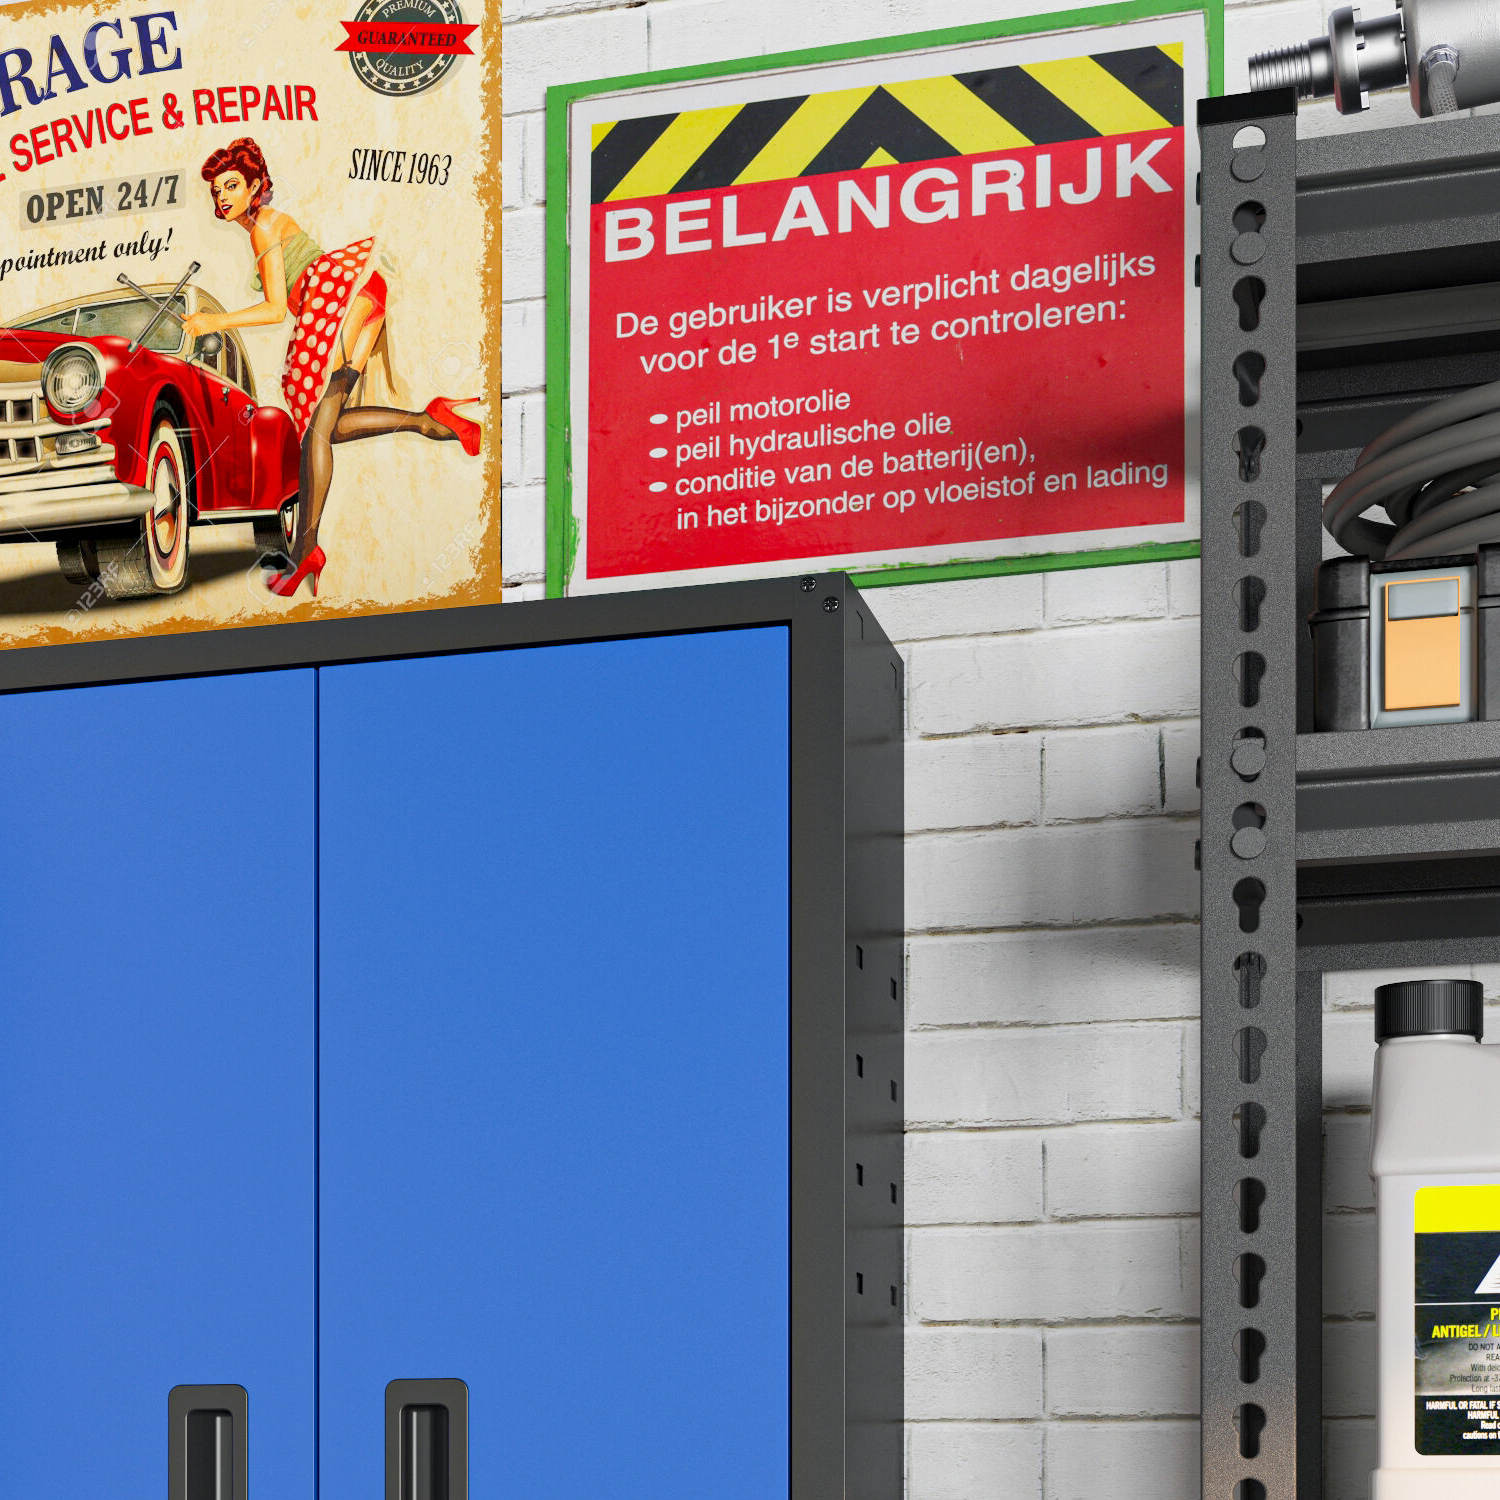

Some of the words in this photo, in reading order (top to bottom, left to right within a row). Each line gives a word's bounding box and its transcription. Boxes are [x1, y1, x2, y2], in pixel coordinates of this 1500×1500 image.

[382, 0, 436, 18] PREMIUM
[357, 31, 456, 46] GUARANTEED
[376, 58, 423, 76] QUALITY
[10, 102, 154, 172] SERVICE
[162, 93, 184, 129] &
[192, 85, 318, 125] REPAIR
[348, 148, 404, 184] SINCE
[408, 152, 452, 185] 1963
[26, 186, 104, 224] OPEN
[118, 175, 180, 210] 24/7
[605, 138, 1173, 262] BELANGRIJK
[113, 228, 174, 268] only!
[615, 310, 658, 340] De
[668, 292, 817, 343] gebruiker
[826, 282, 852, 314] is
[863, 269, 999, 321] verplicht
[1010, 252, 1156, 306] dagelijks
[640, 344, 709, 375] voor
[718, 334, 757, 366] de
[810, 322, 881, 357] start
[890, 318, 921, 348] te
[930, 299, 1126, 343] controleren:
[677, 401, 720, 433] peil
[730, 389, 850, 422] motorolie
[676, 436, 720, 467] peil
[730, 419, 895, 460] hydraulische
[905, 413, 951, 439] olie
[676, 466, 776, 496] conditie
[784, 463, 831, 484] van
[841, 455, 873, 478] de
[882, 437, 1036, 477] batterij(en),
[677, 508, 698, 529] in
[707, 503, 747, 527] het
[755, 491, 875, 525] bijzonder
[883, 489, 915, 513] op
[924, 469, 1035, 504] vloeistof
[1043, 466, 1077, 492] en
[1087, 462, 1168, 490] lading
[1432, 1325, 1482, 1338] ANTIGEL
[1450, 1375, 1482, 1383] Protection
[1471, 1364, 1486, 1372] With
[1426, 1401, 1457, 1410] HARMFUL
[1458, 1401, 1468, 1410] OR
[1469, 1401, 1488, 1410] FATAL
[1471, 1386, 1487, 1394] Long
[1467, 1411, 1499, 1419] HARMFUL
[1481, 1421, 1496, 1429] Read
